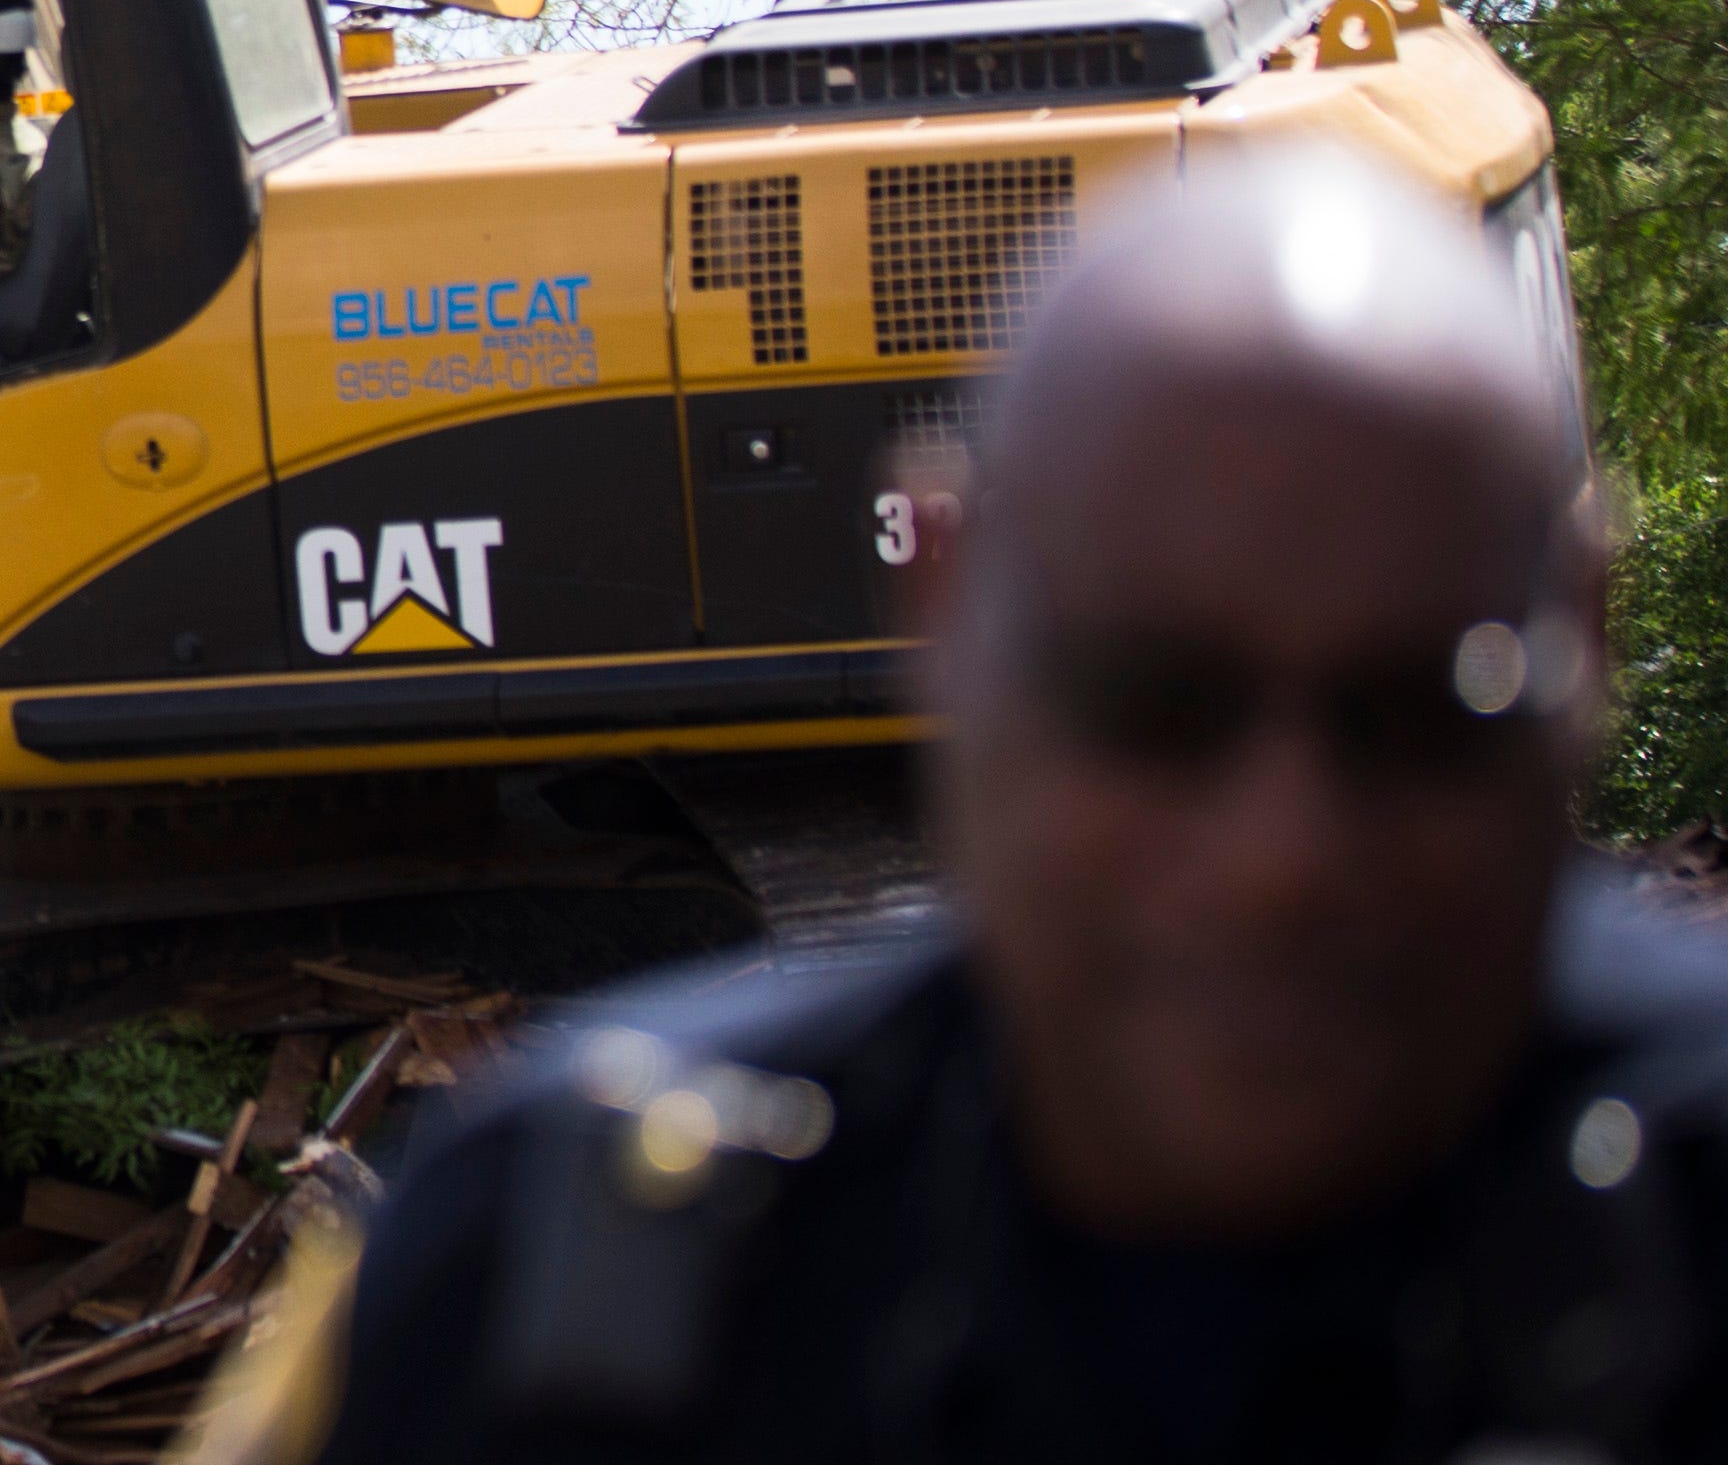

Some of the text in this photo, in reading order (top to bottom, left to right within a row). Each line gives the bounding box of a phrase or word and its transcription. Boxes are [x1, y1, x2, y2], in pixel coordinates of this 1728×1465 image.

[332, 275, 590, 341] BLUECAT
[338, 349, 598, 402] 956-464-0123
[295, 518, 503, 656] CAT
